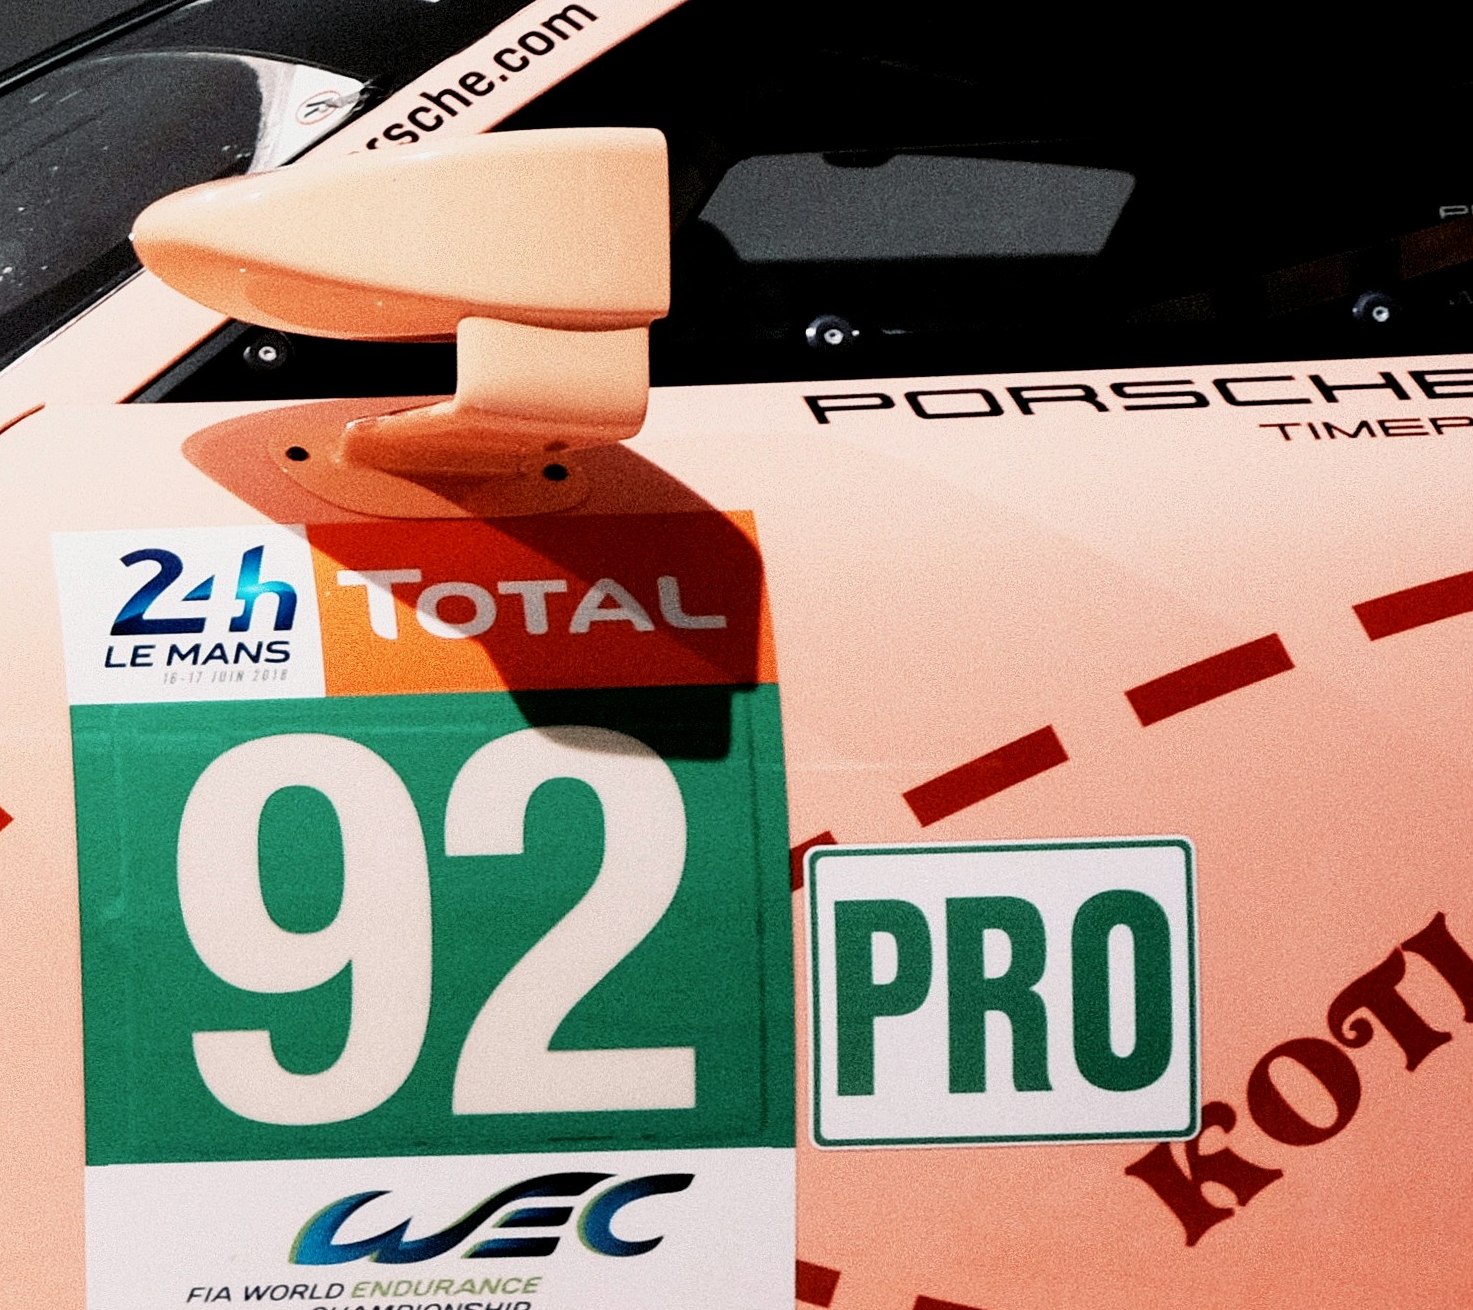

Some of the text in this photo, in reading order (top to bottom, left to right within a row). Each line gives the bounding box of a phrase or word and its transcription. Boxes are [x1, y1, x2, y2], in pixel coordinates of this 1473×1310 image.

[109, 544, 298, 637] 24h
[337, 569, 727, 641] TOTAL
[104, 640, 291, 669] LE MANS
[163, 668, 289, 685] 16-17 JUIN 2018
[176, 725, 697, 1126] 92
[833, 888, 1175, 1098] PRO
[287, 1171, 697, 1266] WEC
[186, 1275, 544, 1304] FIA WORLD ENDURANCE
